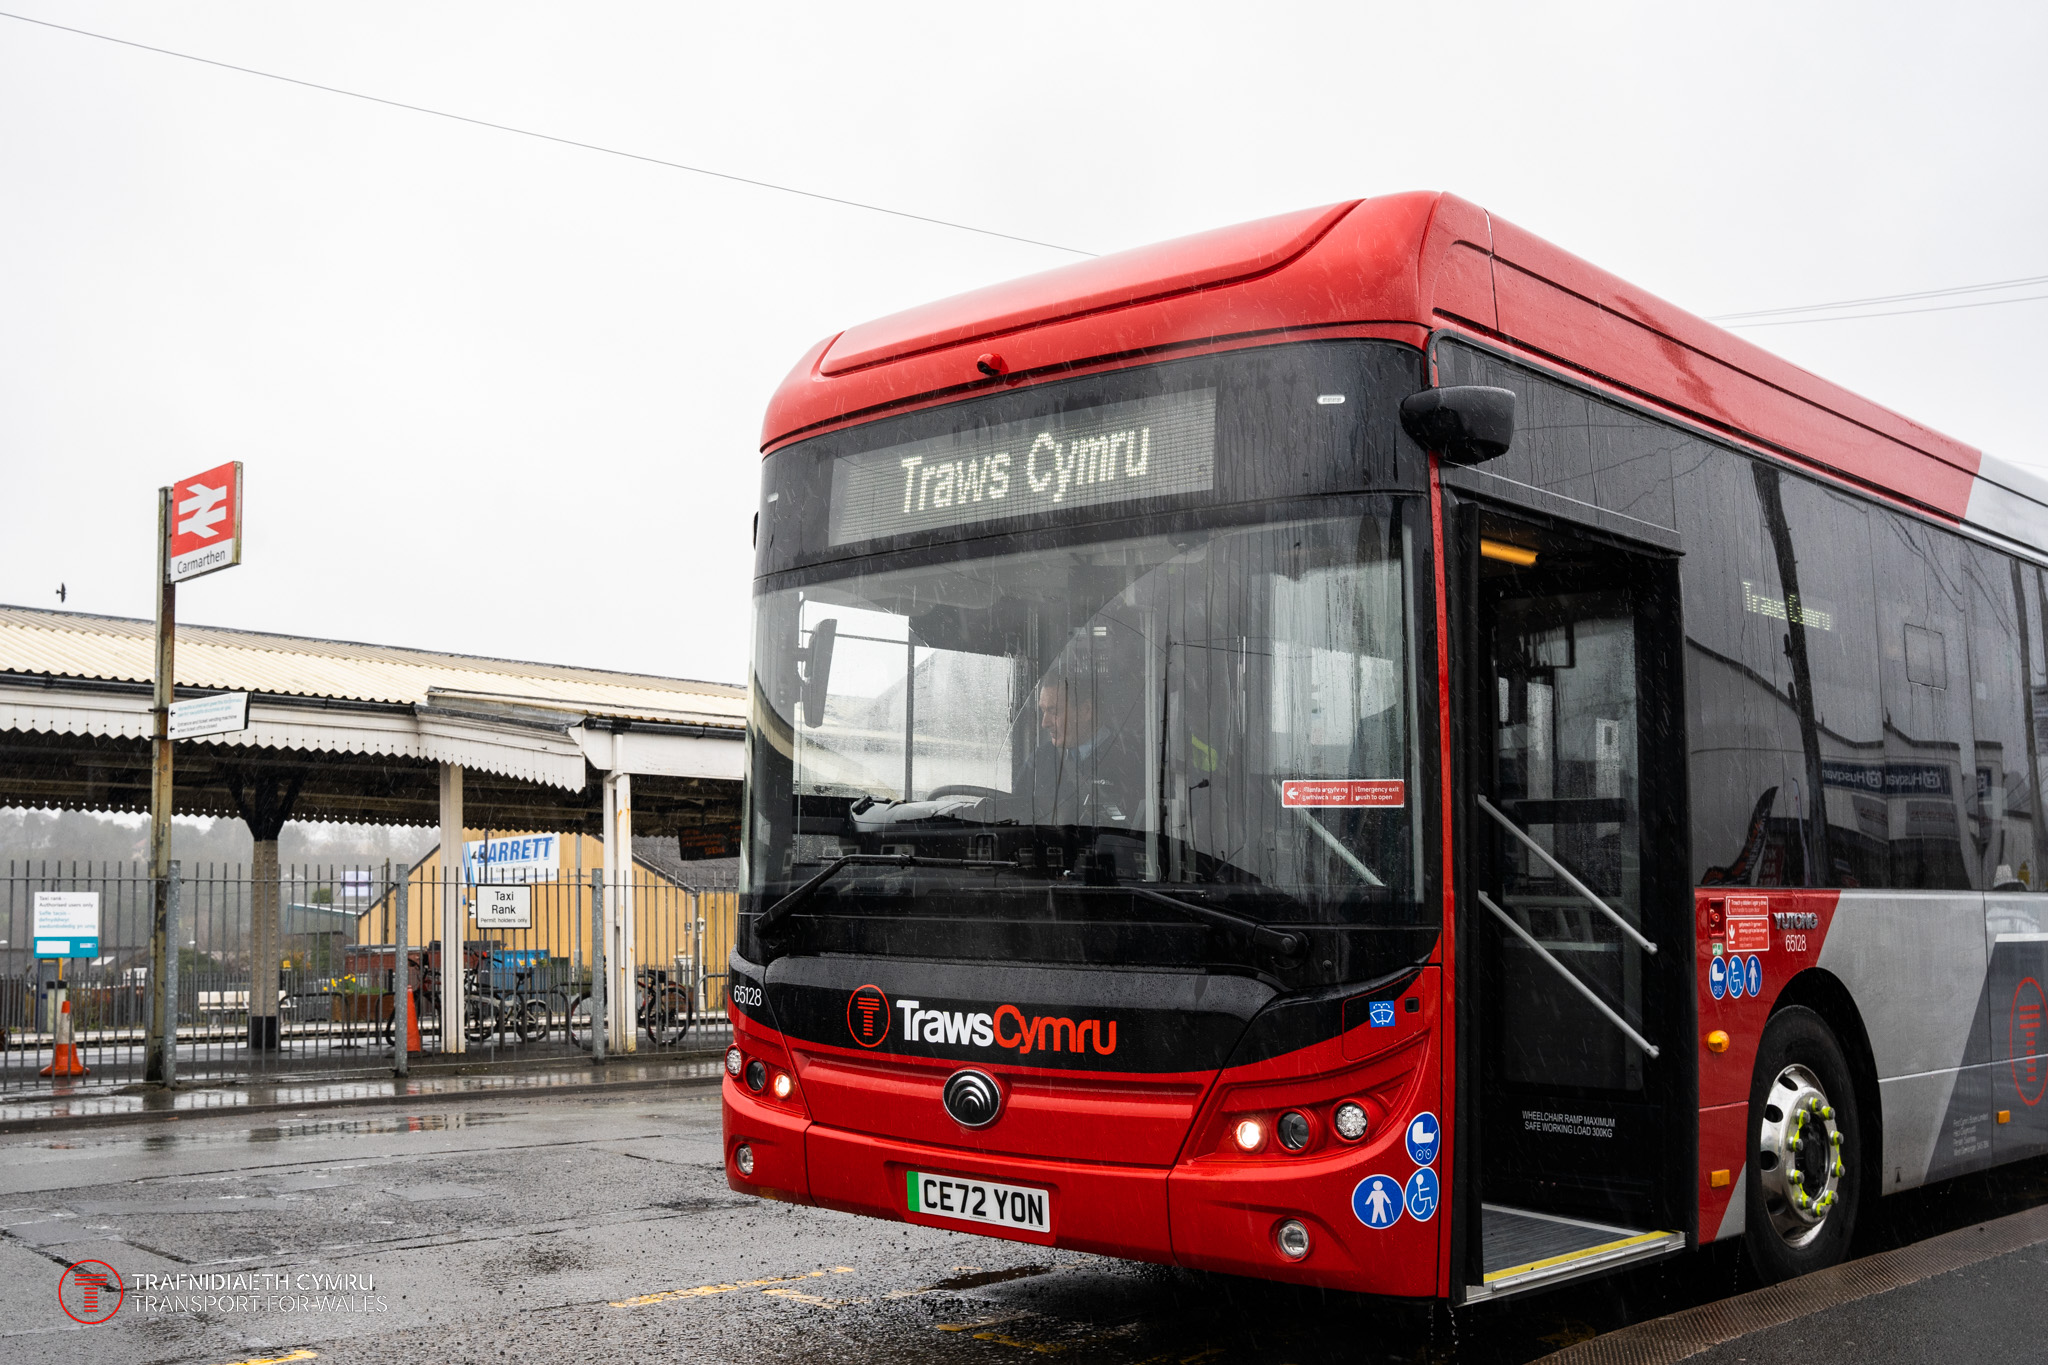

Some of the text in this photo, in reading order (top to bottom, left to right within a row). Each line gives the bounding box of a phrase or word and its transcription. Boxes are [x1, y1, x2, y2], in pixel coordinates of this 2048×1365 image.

[901, 427, 1150, 513] Traws Cymru
[177, 550, 226, 574] Carmarthen
[1357, 785, 1388, 794] Emergency
[477, 836, 553, 864] BARRETT
[495, 891, 514, 900] Taxi
[491, 904, 516, 914] Rank
[1773, 912, 1818, 930] YUTONG
[1785, 934, 1807, 952] 65128
[734, 984, 762, 1007] 65128
[896, 999, 1117, 1055] TrawsCymru
[1522, 1110, 1615, 1127] WHEELCHAIR RAMP MAXIMUM
[1524, 1121, 1613, 1138] SAFE WORKING LOAD 300KG
[923, 1179, 1043, 1226] CE72 YON
